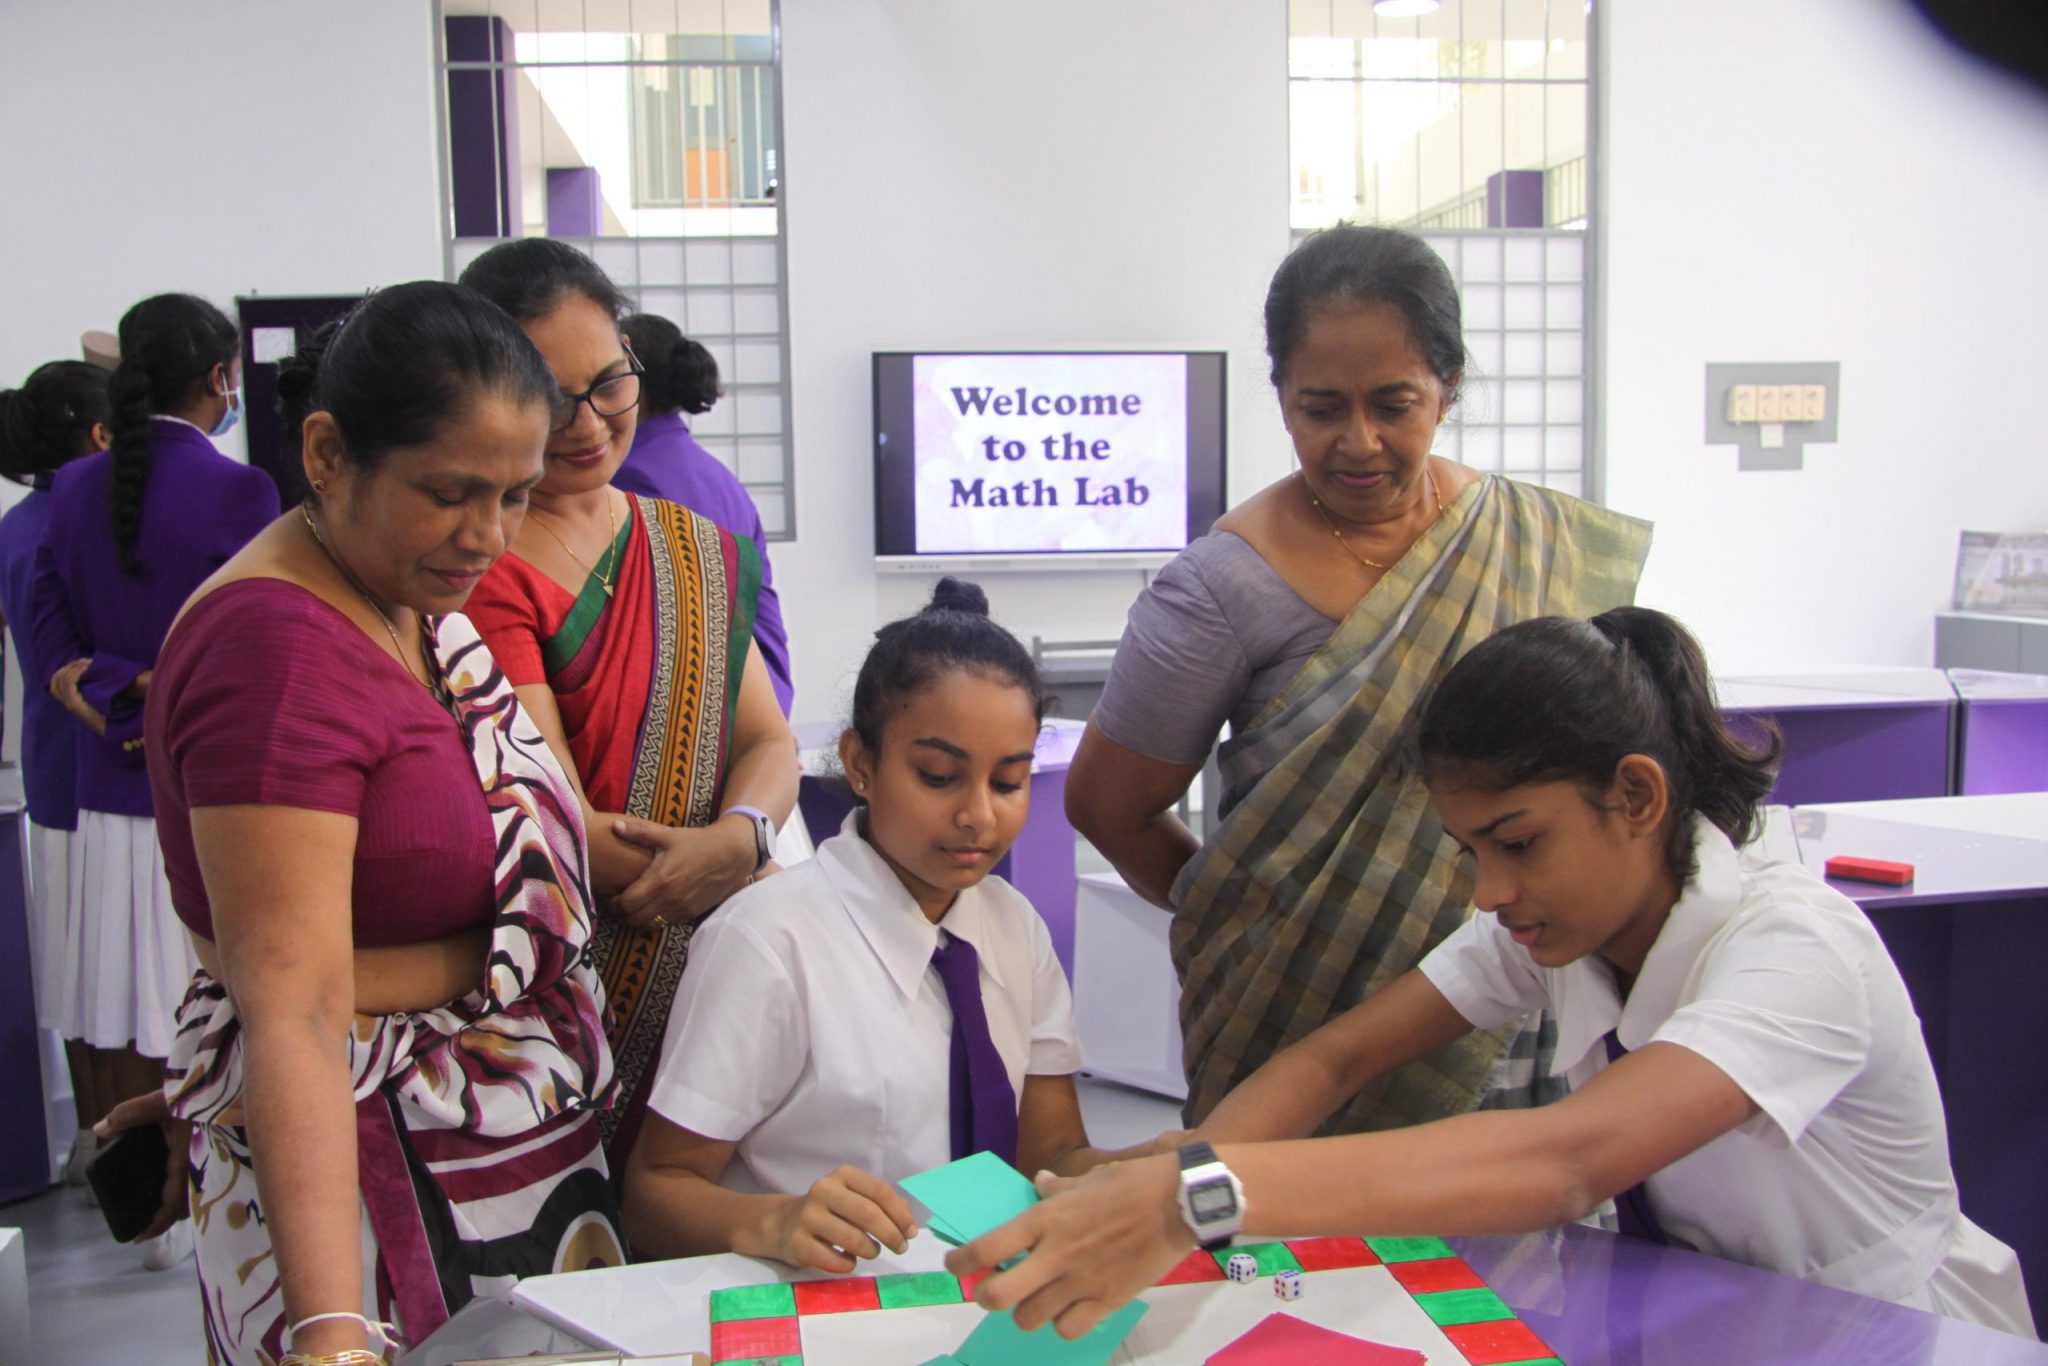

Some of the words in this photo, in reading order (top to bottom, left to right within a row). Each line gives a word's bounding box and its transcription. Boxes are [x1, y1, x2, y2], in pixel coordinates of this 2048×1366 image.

[950, 386, 1142, 417] Welcome
[981, 435, 1027, 462] to
[1041, 431, 1111, 461] the
[949, 477, 1059, 508] Math
[1074, 476, 1150, 507] Lab
